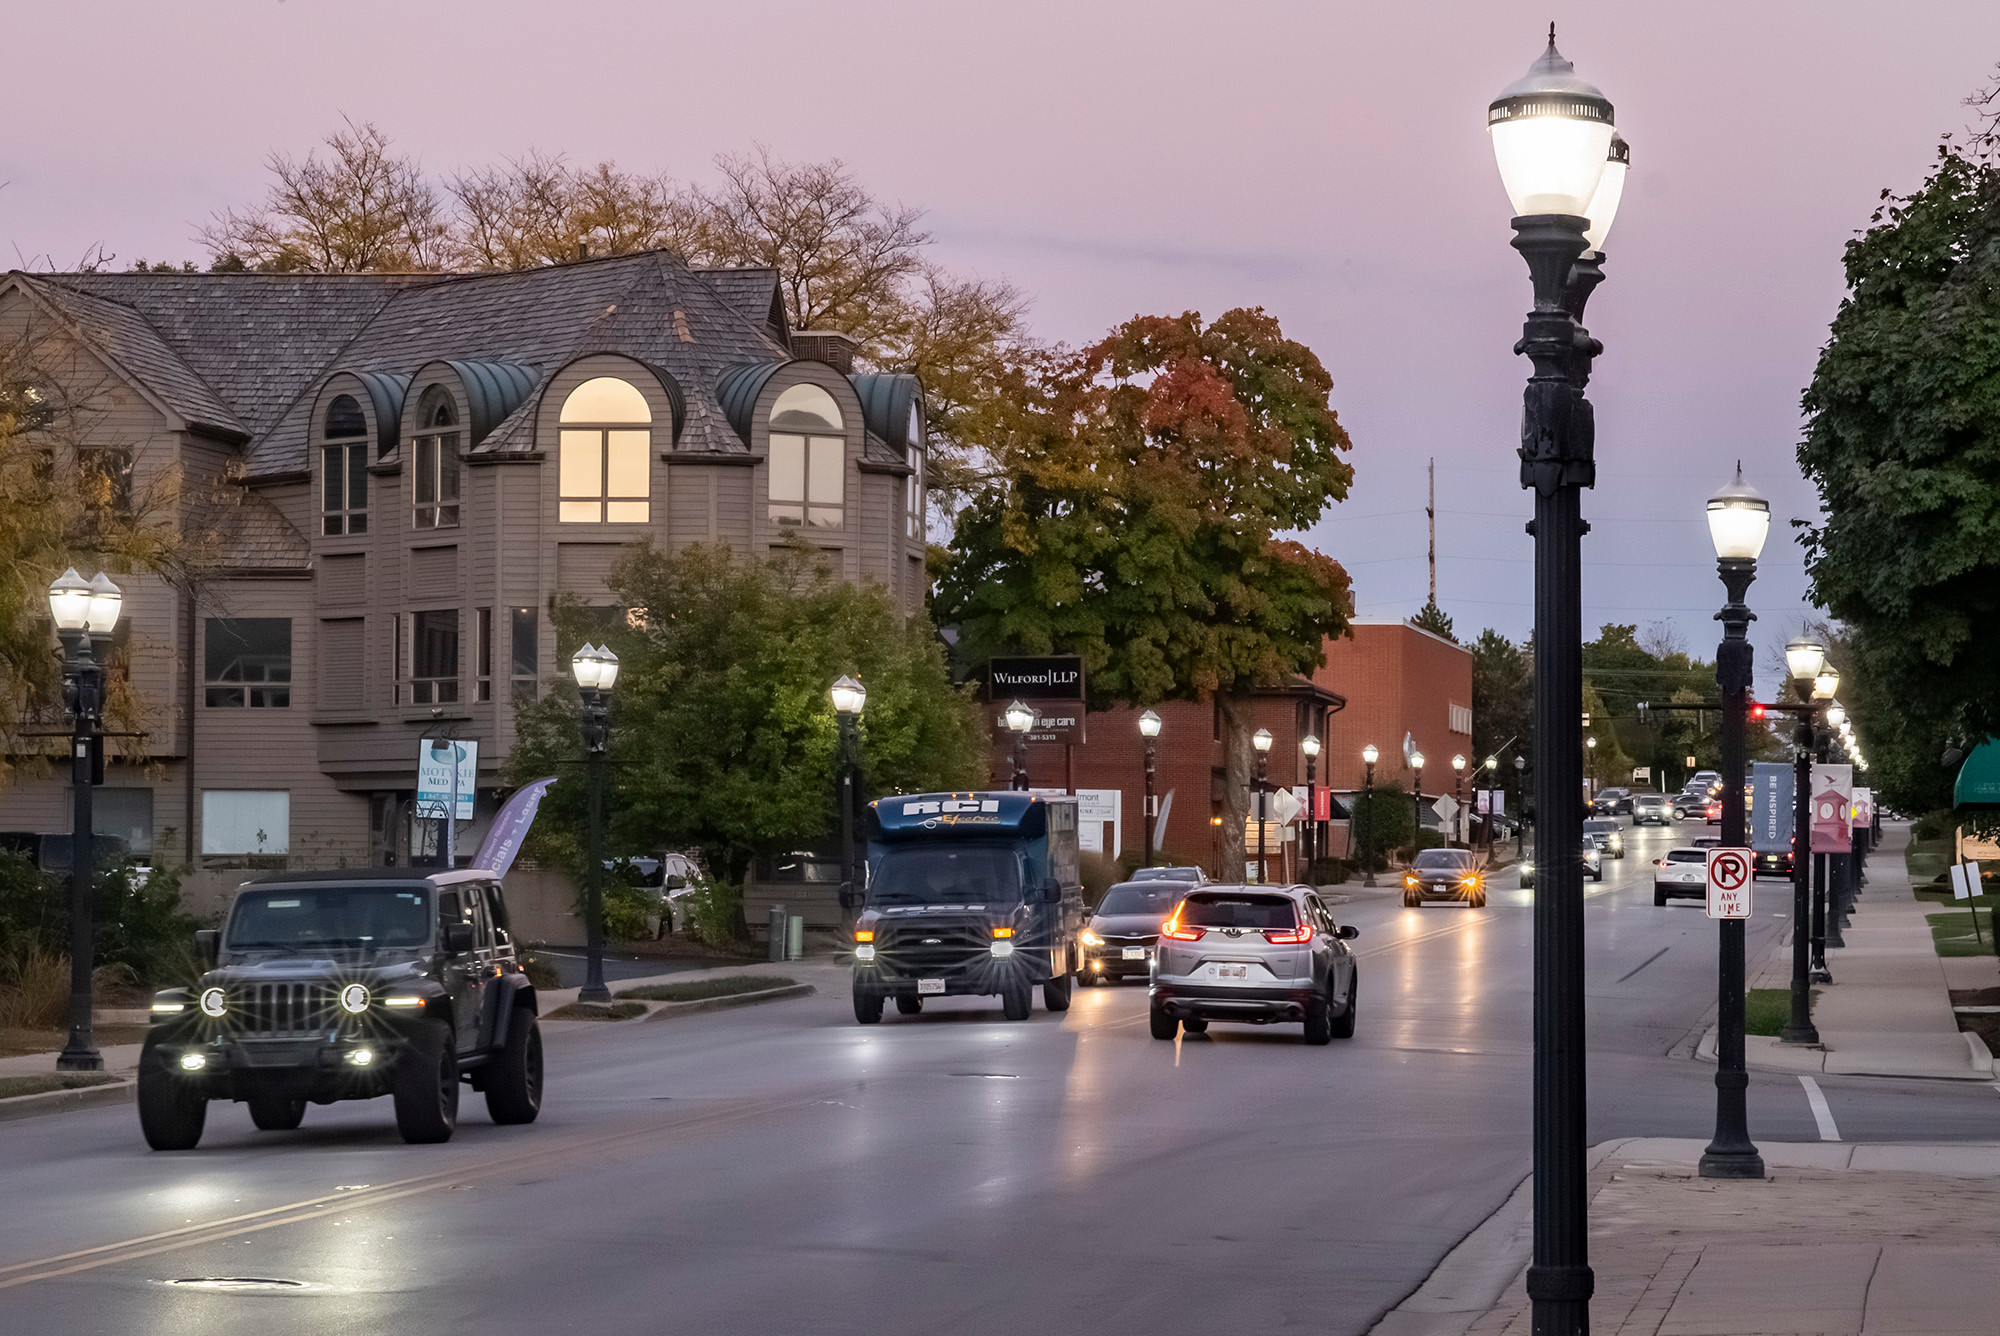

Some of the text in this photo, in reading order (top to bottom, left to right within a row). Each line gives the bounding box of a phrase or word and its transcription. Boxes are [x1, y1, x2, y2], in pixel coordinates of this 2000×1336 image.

[1041, 718, 1056, 728] eye
[1057, 718, 1075, 726] care
[428, 777, 448, 786] MED
[515, 787, 542, 824] Laser
[902, 800, 999, 816] RCI
[1768, 775, 1777, 839] BE INSPIRED
[1721, 893, 1737, 901] ANY
